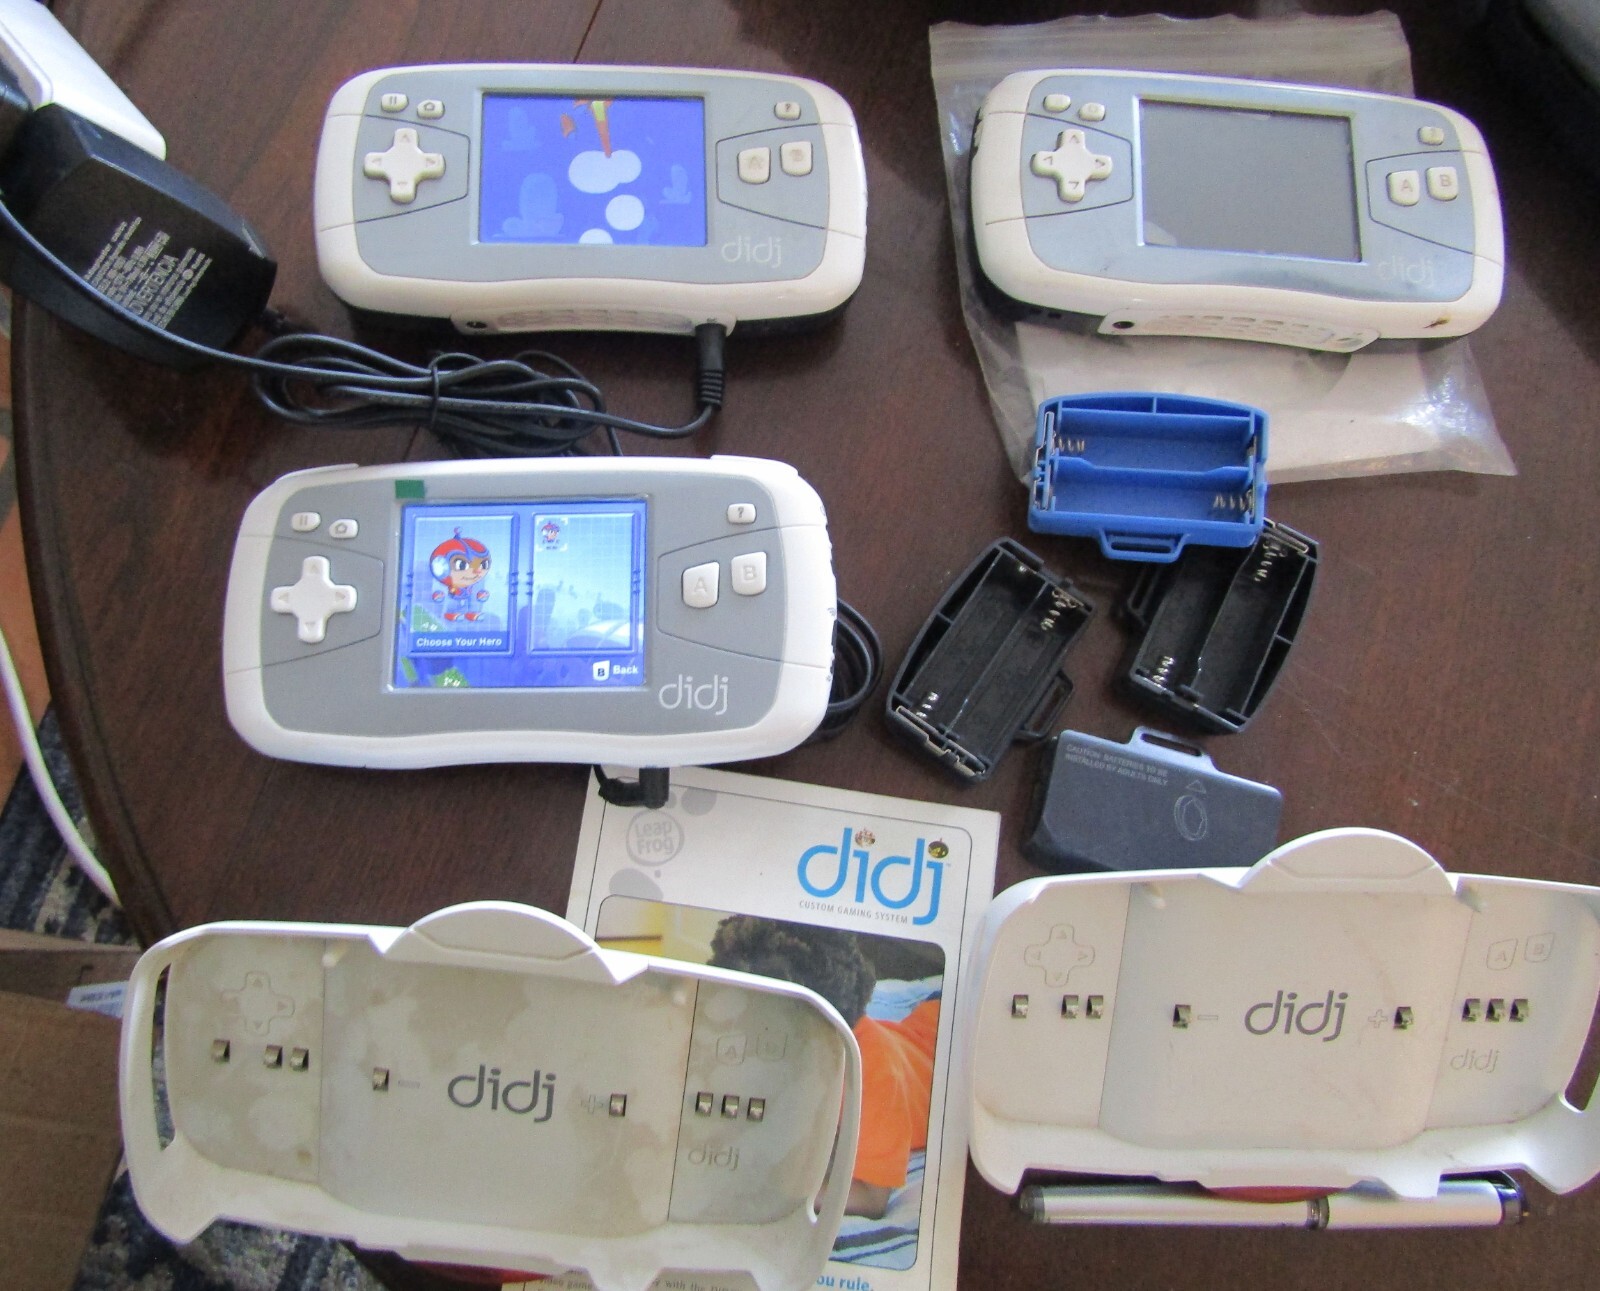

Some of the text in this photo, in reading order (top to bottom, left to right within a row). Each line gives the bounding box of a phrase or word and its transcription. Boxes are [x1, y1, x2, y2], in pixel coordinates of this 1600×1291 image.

[721, 236, 782, 268] didj
[694, 577, 708, 592] A
[743, 565, 756, 580] B
[416, 637, 502, 647] Choose Your Hero
[597, 664, 638, 677] B Back
[659, 674, 728, 715] didj
[635, 821, 672, 840] Leap
[636, 837, 674, 855] Frog
[797, 827, 948, 926] didj
[799, 900, 908, 924] CUSTOM GAMING SYSTEM
[1244, 990, 1348, 1042] didj
[1450, 1048, 1500, 1073] didj
[447, 1064, 556, 1122] didj
[688, 1145, 740, 1171] didj
